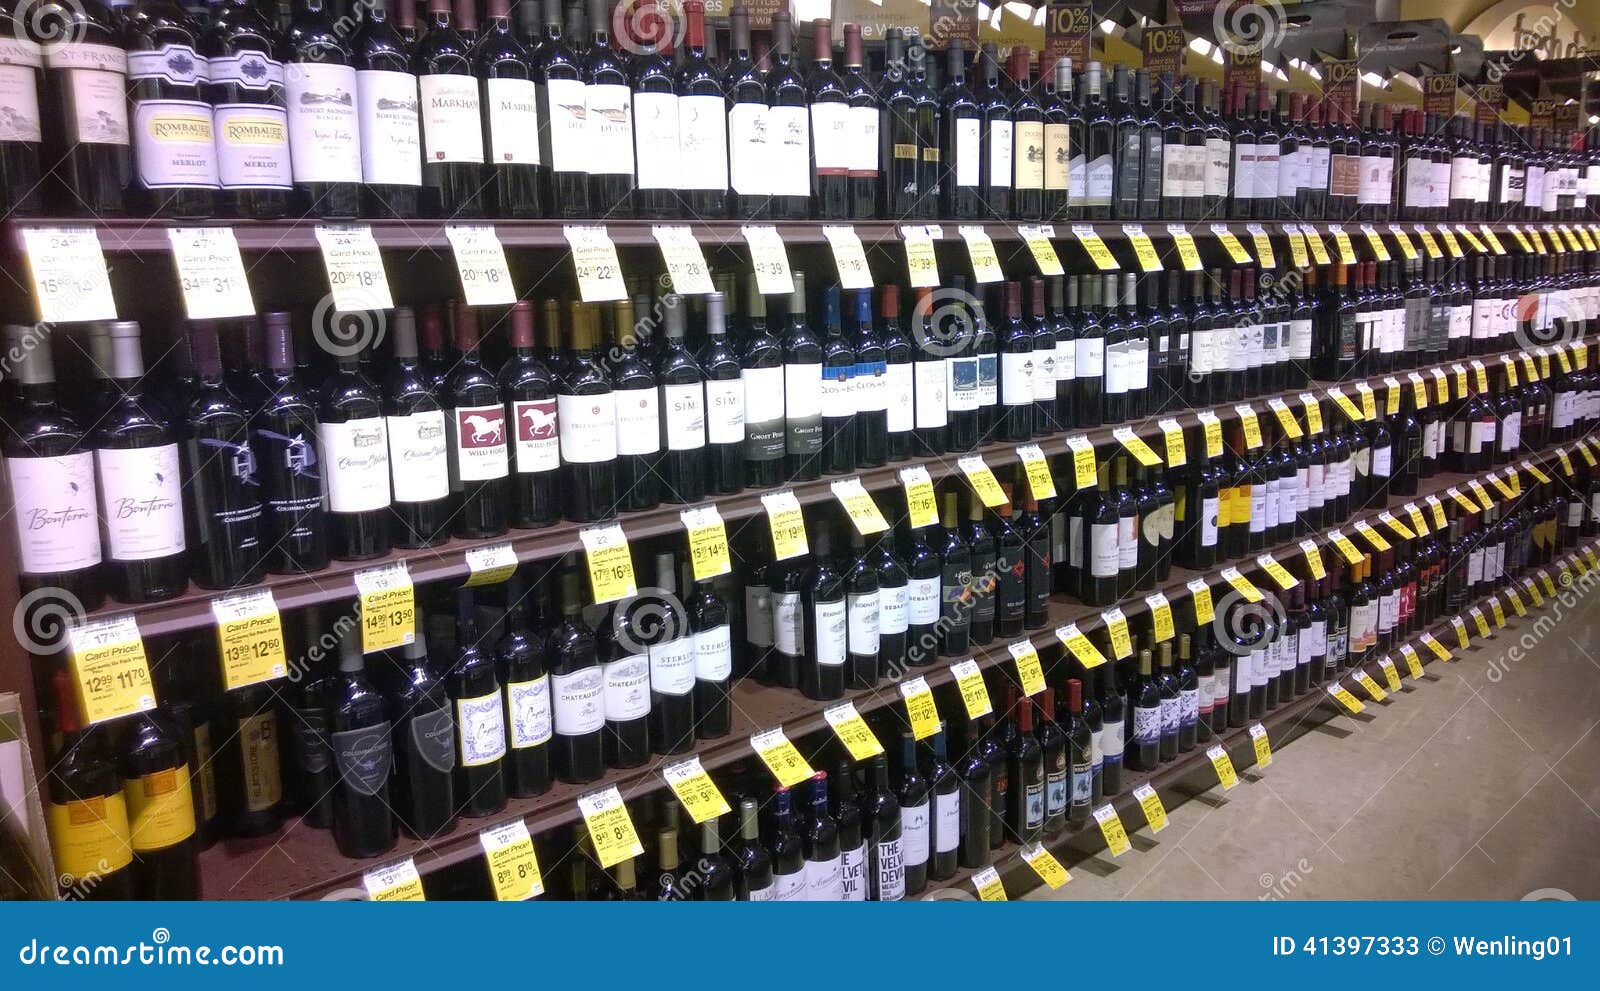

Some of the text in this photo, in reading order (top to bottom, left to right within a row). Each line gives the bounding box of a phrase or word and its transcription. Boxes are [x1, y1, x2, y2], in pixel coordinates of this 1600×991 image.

[243, 161, 278, 169] MERLOT
[226, 616, 276, 633] Card Price!
[84, 643, 140, 662] Card Price!
[880, 841, 899, 857] THE
